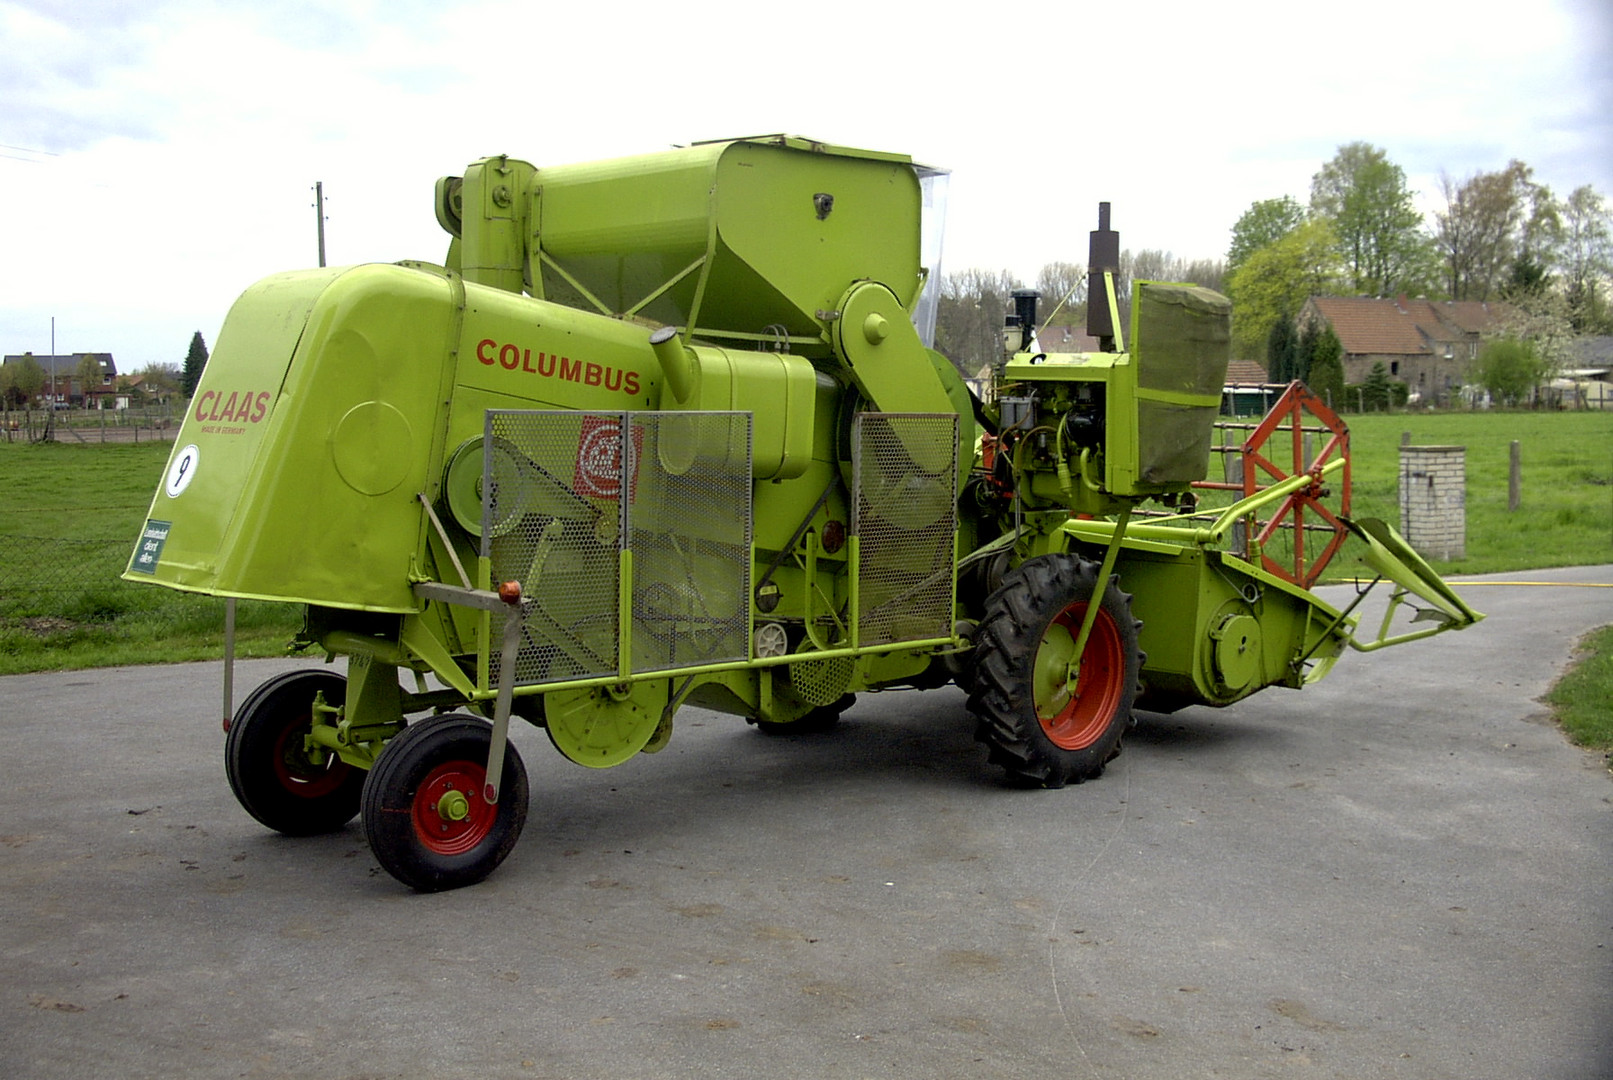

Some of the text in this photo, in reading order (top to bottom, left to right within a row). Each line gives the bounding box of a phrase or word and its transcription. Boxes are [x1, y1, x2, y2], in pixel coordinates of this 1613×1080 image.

[477, 339, 640, 395] COLUMBUS
[195, 390, 270, 423] CLAAS
[174, 455, 190, 487] 9
